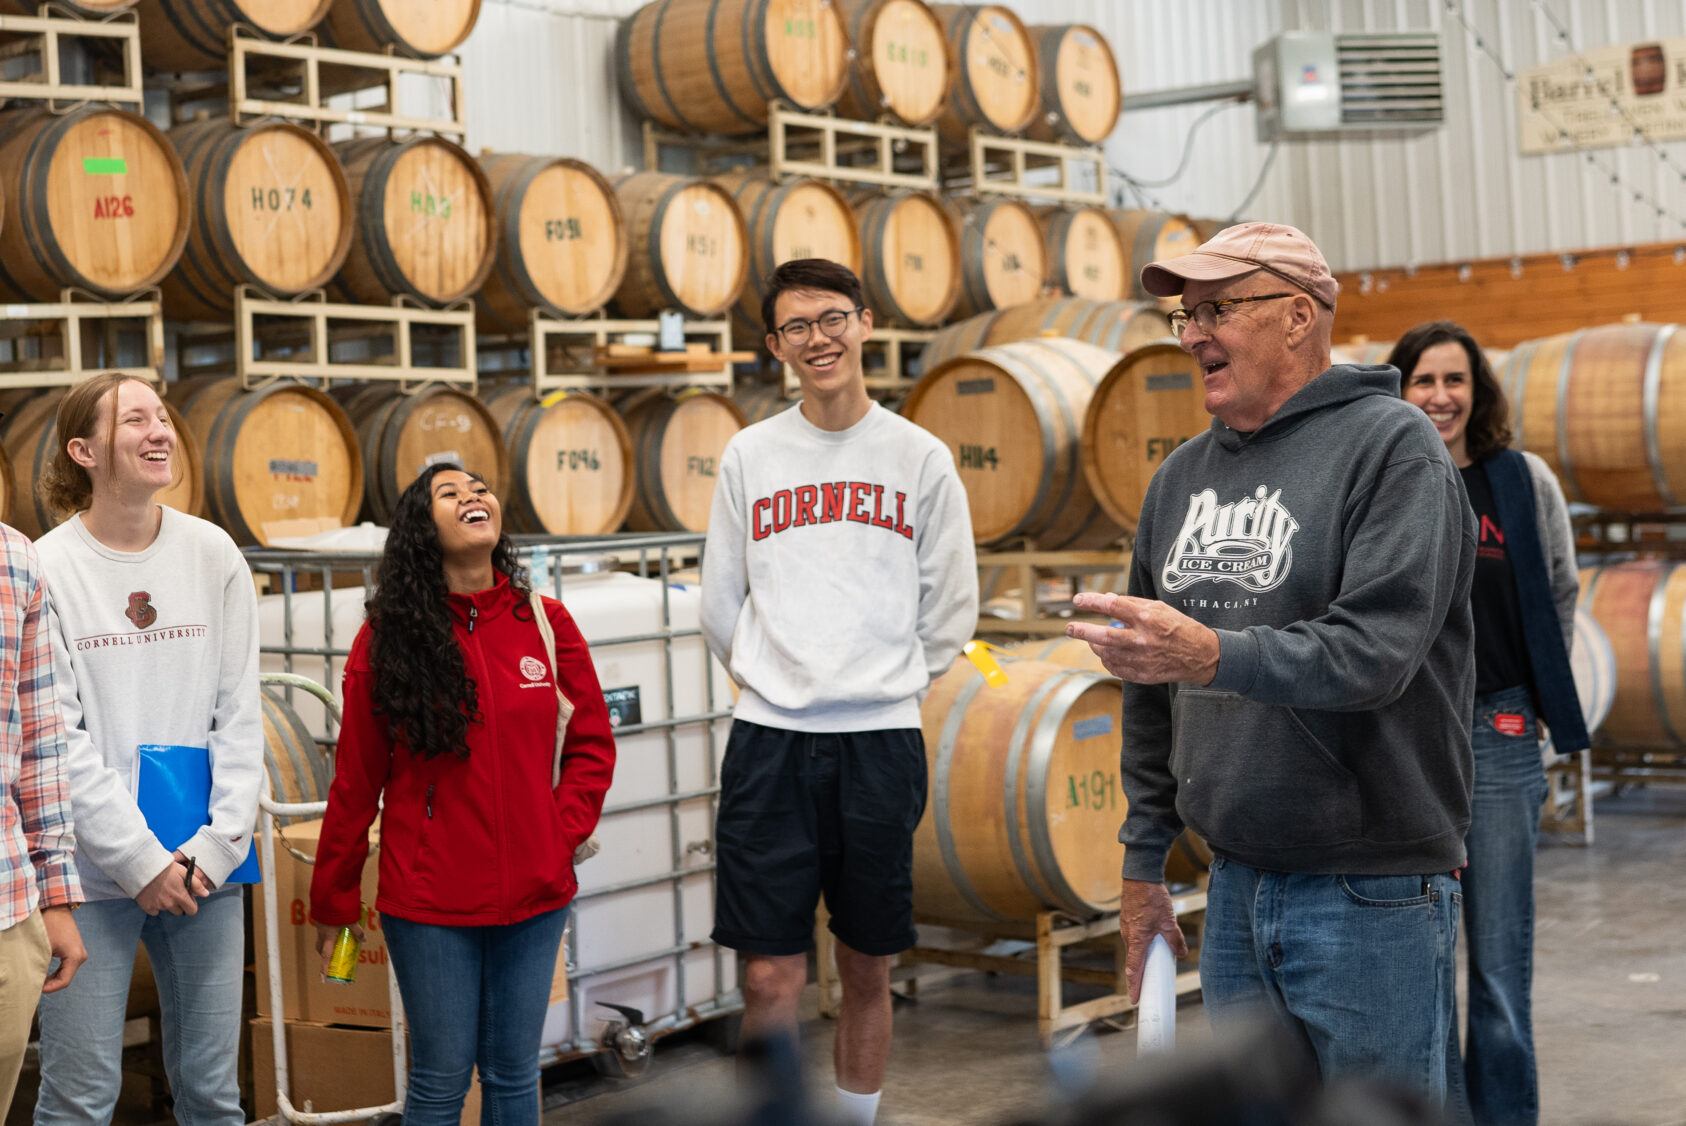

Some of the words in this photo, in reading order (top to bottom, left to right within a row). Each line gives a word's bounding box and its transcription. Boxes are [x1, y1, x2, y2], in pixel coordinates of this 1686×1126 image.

[94, 195, 134, 219] A126
[251, 187, 312, 212] H074
[752, 481, 913, 541] CORNELL
[1167, 485, 1299, 578] Purity
[1181, 560, 1213, 570] ICE
[1217, 556, 1268, 572] CREAM
[77, 637, 133, 651] CORNELL
[136, 628, 206, 644] UNIVERSITY
[1066, 770, 1116, 811] A191
